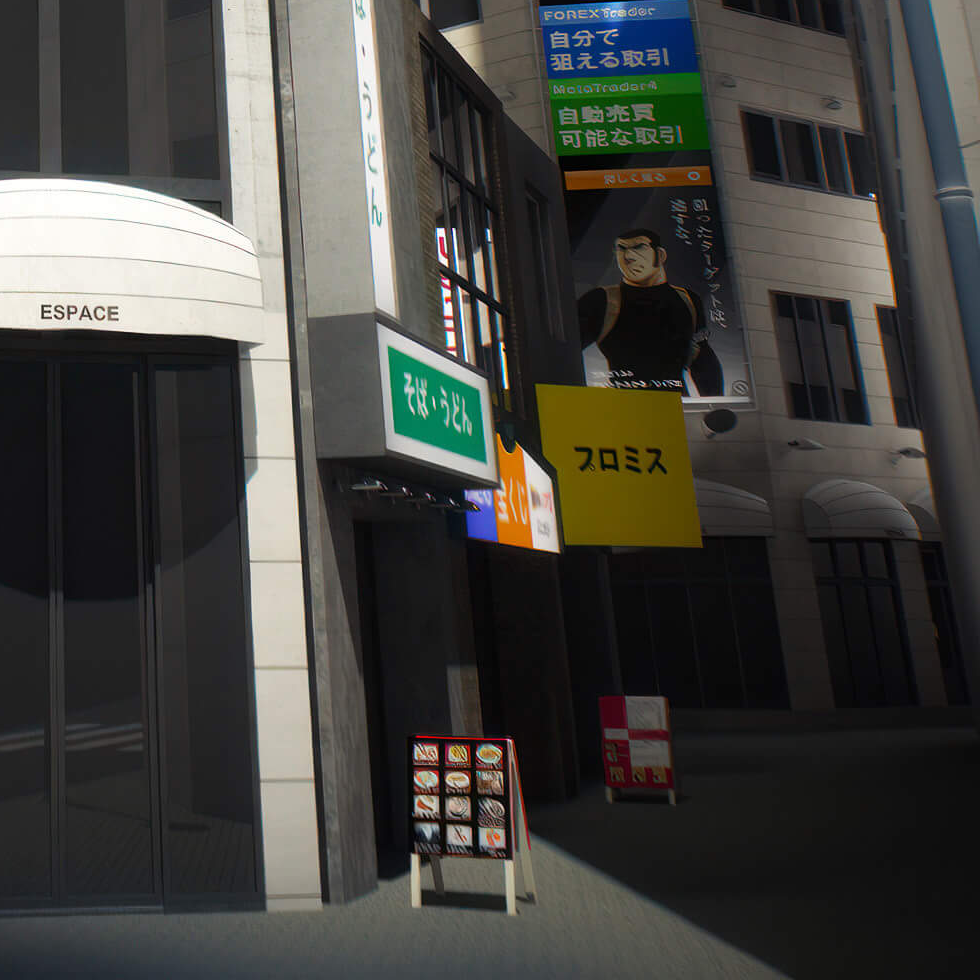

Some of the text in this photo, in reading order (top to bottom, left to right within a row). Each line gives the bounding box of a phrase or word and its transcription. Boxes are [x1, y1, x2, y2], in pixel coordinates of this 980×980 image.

[549, 28, 620, 49] 自分で
[550, 48, 670, 71] 狙える取引
[558, 103, 657, 126] 自動売買
[558, 125, 684, 149] 可能な取引
[40, 304, 120, 322] ESPACE
